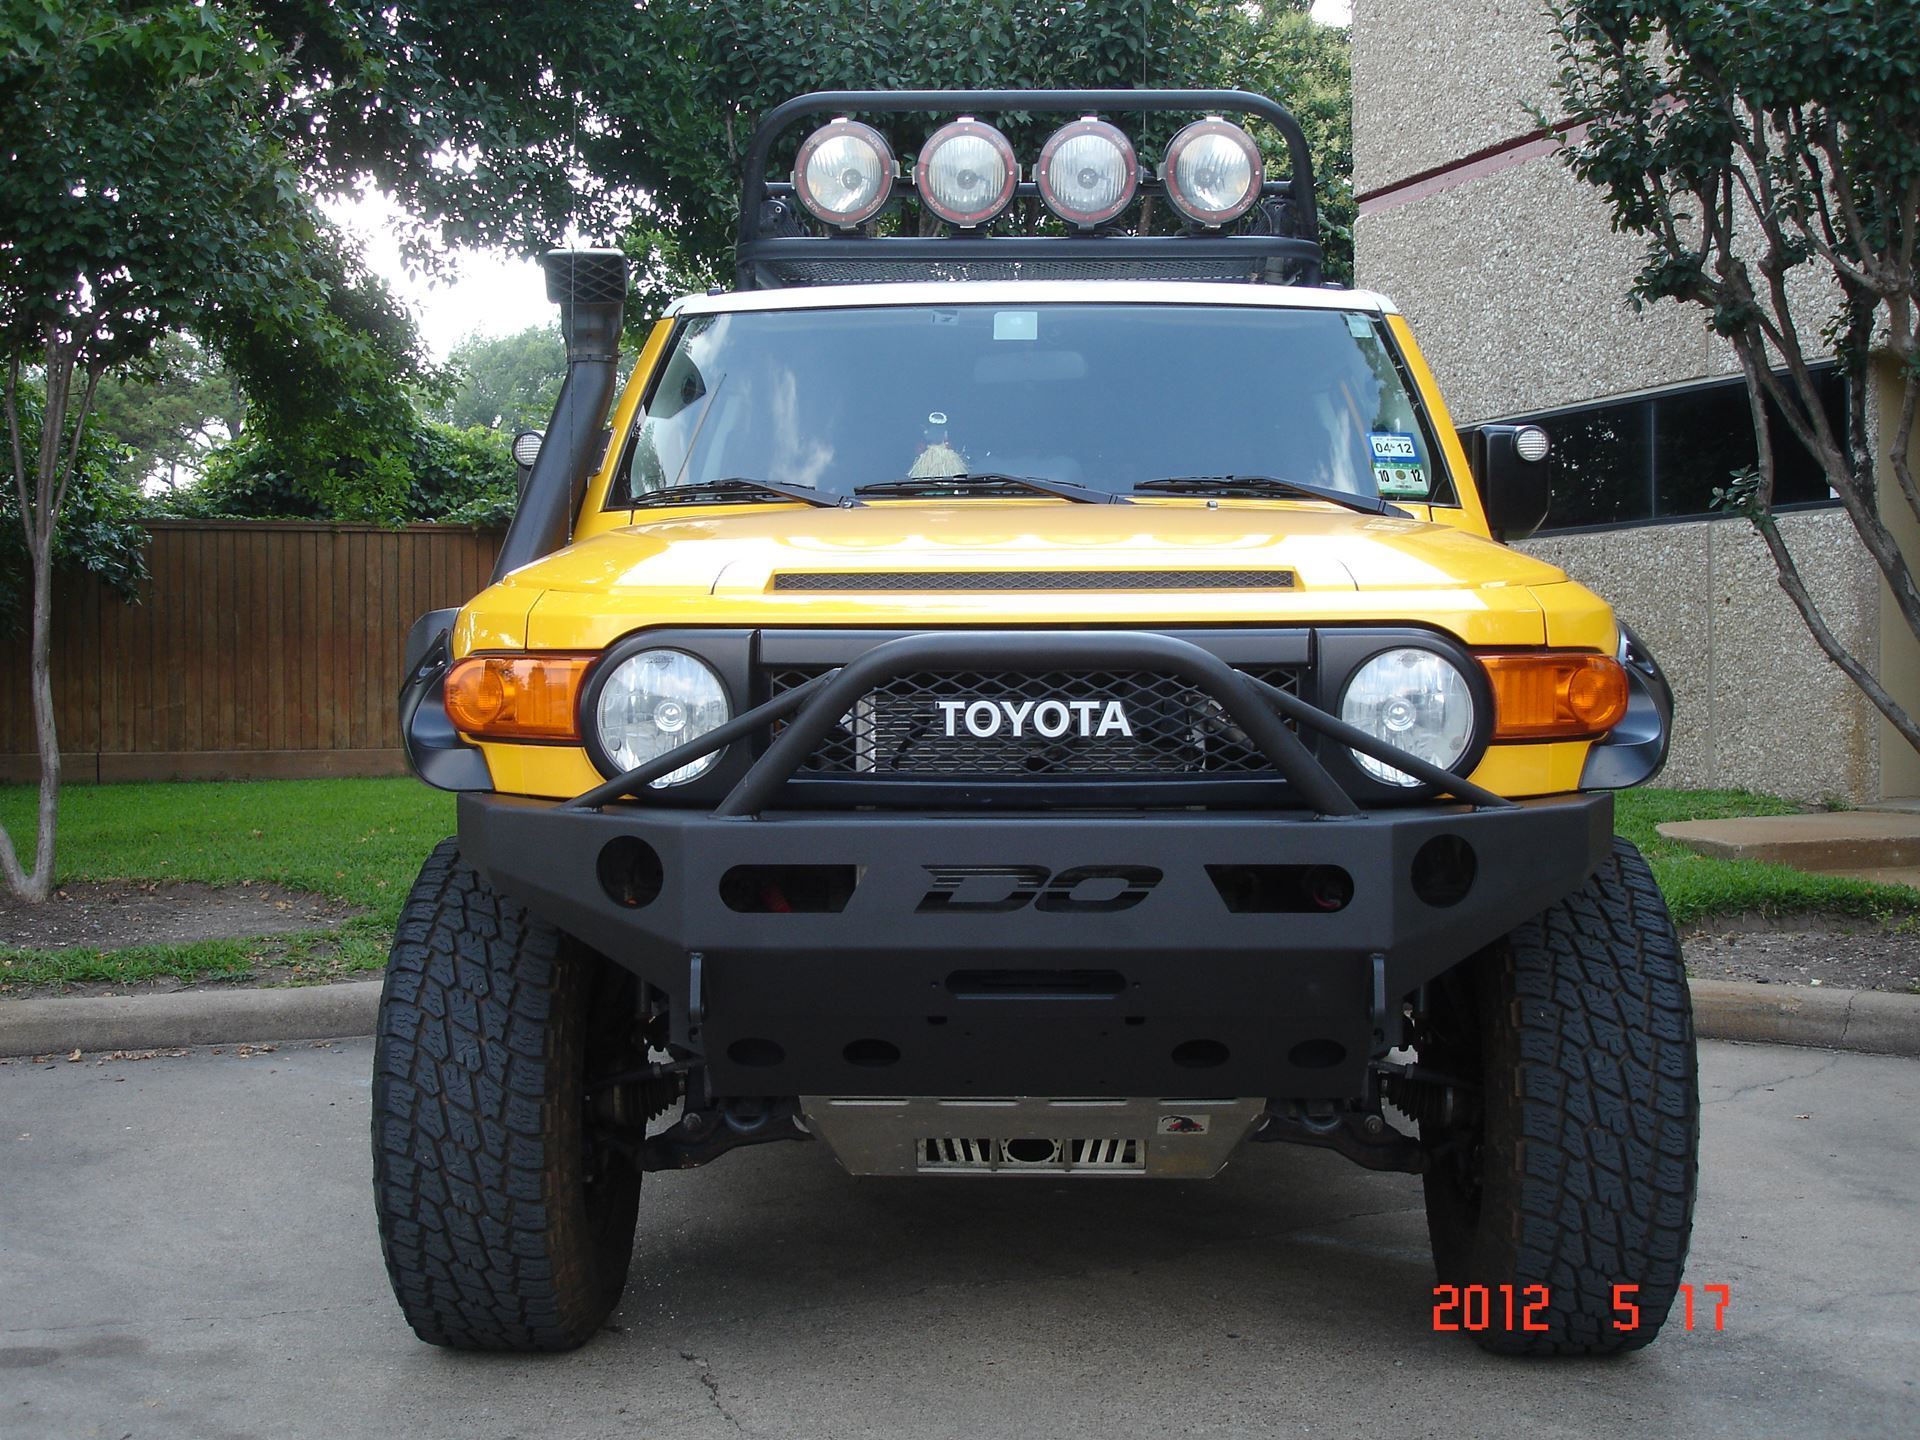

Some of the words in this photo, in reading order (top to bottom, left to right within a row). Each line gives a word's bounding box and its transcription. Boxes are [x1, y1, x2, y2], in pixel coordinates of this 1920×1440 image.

[1378, 469, 1390, 483] 10
[1410, 468, 1423, 482] 12
[935, 700, 1134, 738] TOYOTA
